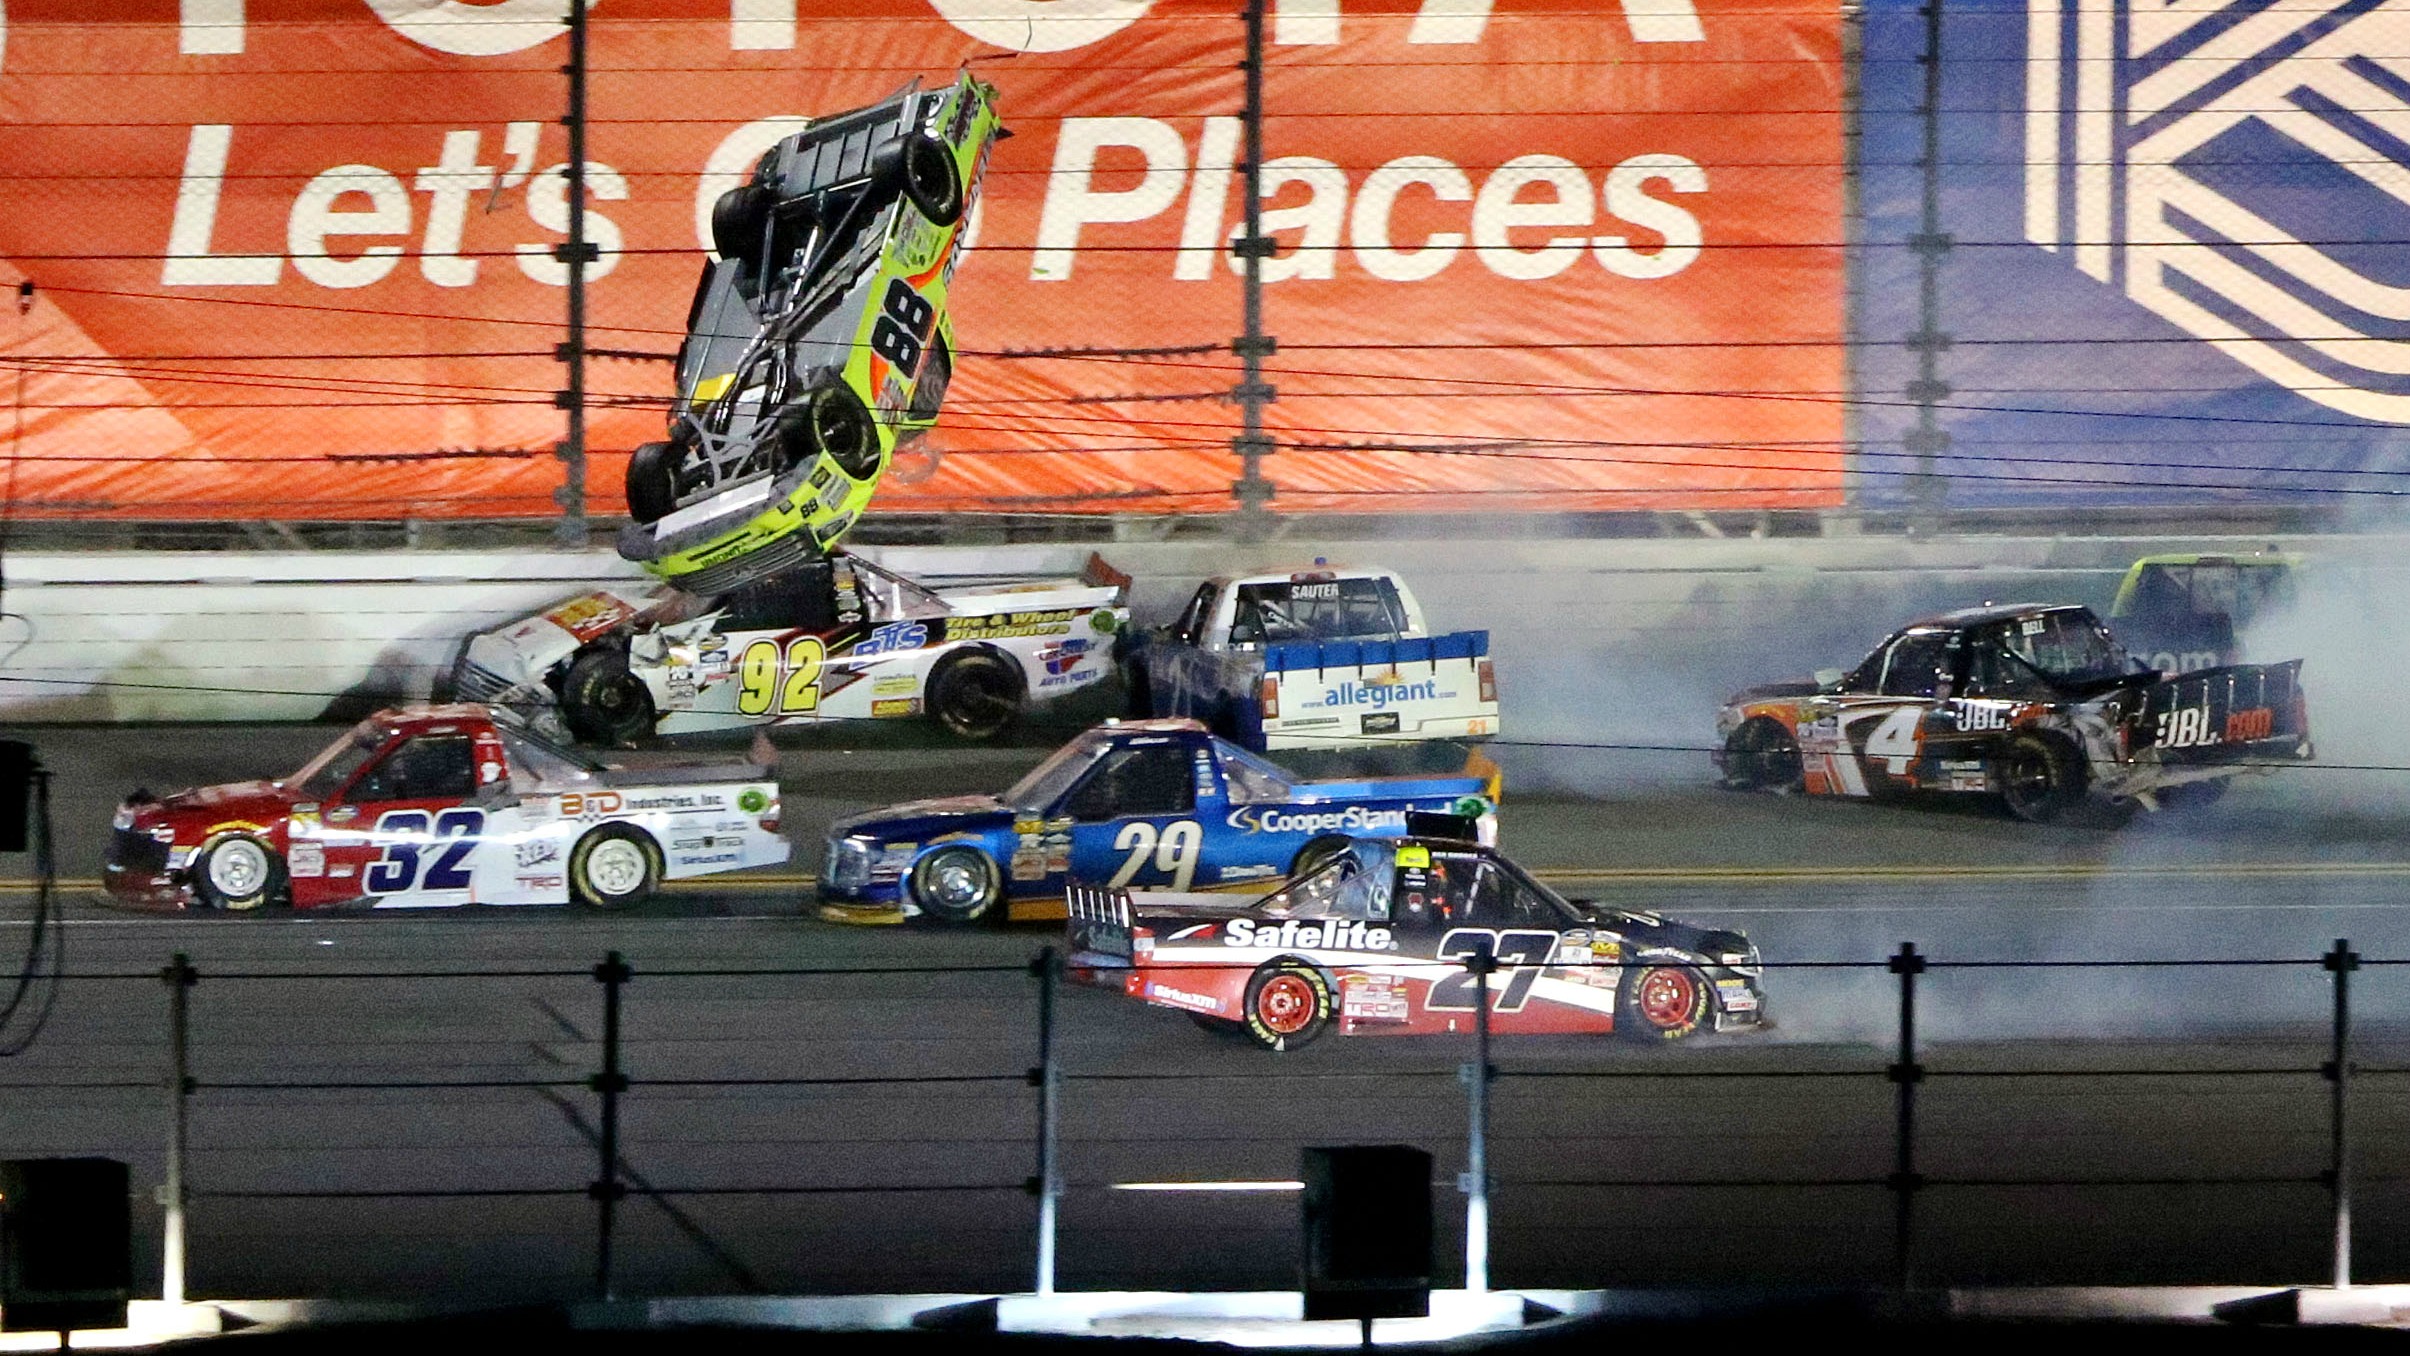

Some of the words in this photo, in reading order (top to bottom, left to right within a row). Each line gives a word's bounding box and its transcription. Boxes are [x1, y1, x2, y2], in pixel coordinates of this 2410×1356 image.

[162, 122, 629, 288] Let's
[1029, 114, 1709, 284] Places
[869, 275, 934, 382] 88
[800, 497, 819, 519] 88
[945, 616, 986, 629] Tire
[1011, 609, 1077, 624] Wheel
[1290, 583, 1340, 600] SAUTER
[945, 623, 1071, 641] Distributors
[738, 637, 827, 719] 92
[1466, 719, 1488, 735] 21
[1863, 695, 1925, 776] 4
[361, 807, 488, 897] 32
[1108, 820, 1203, 893] 29
[1260, 802, 1452, 836] CooperStan
[1424, 928, 1560, 1013] 27
